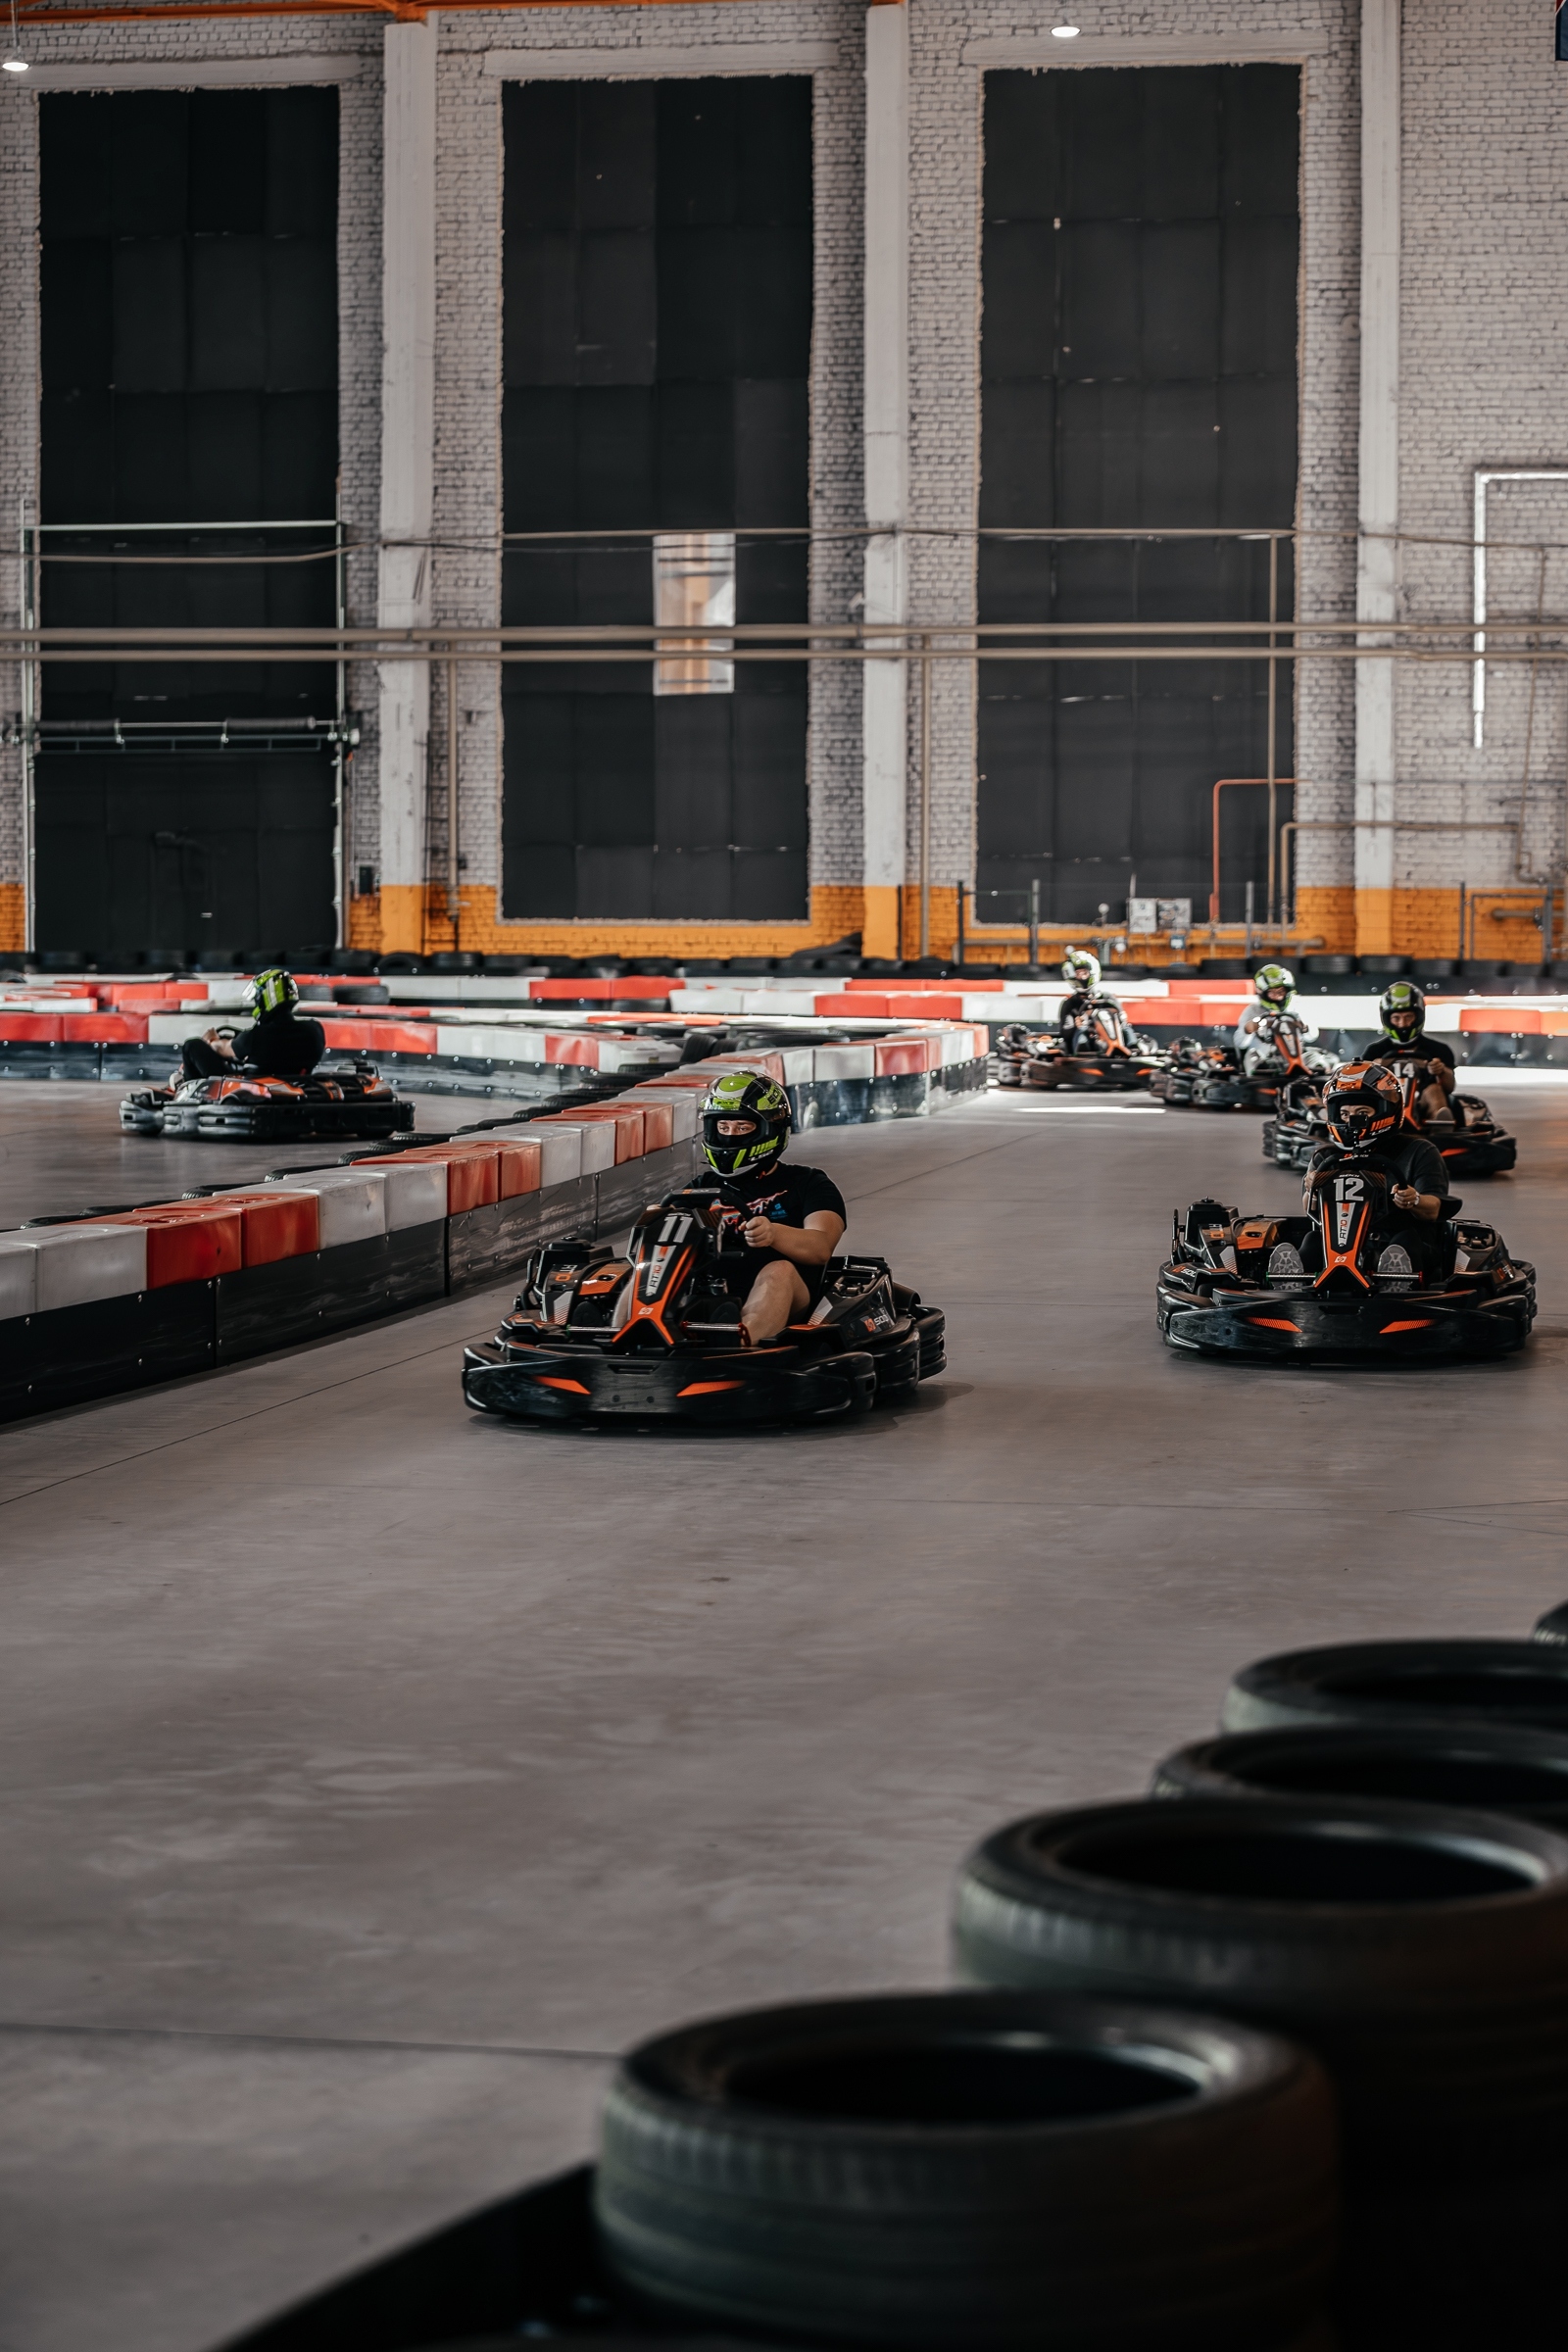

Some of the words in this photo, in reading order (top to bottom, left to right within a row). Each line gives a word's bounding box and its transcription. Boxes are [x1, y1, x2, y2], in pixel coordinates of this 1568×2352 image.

[1393, 1062, 1415, 1078] 14
[1333, 1177, 1365, 1201] 12
[658, 1215, 694, 1243] 11
